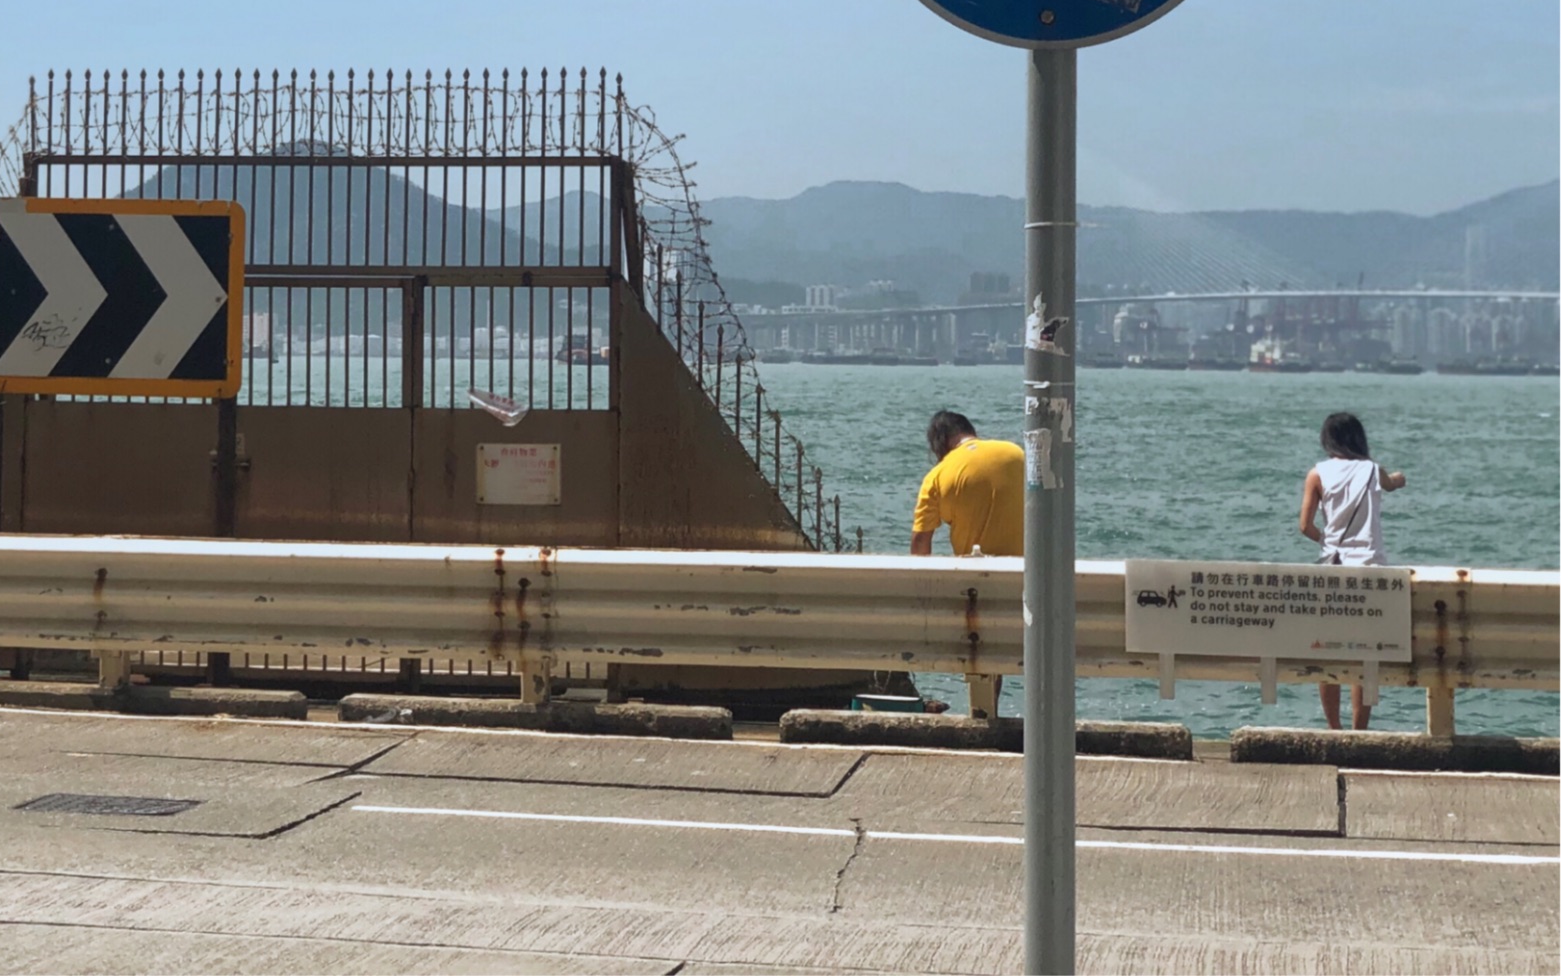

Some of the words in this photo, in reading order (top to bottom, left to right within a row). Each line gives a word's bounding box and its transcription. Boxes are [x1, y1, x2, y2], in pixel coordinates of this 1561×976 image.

[1190, 587, 1204, 597] To
[1208, 589, 1254, 600] prevent
[1326, 593, 1366, 604] please
[1191, 601, 1206, 611] do
[1210, 602, 1230, 612] not
[1234, 603, 1259, 615] stay
[1263, 604, 1285, 614] and
[1290, 605, 1316, 615] take
[1320, 606, 1363, 618] photos
[1367, 608, 1383, 617] on
[1191, 616, 1197, 624] a
[1201, 615, 1275, 628] carriageway
